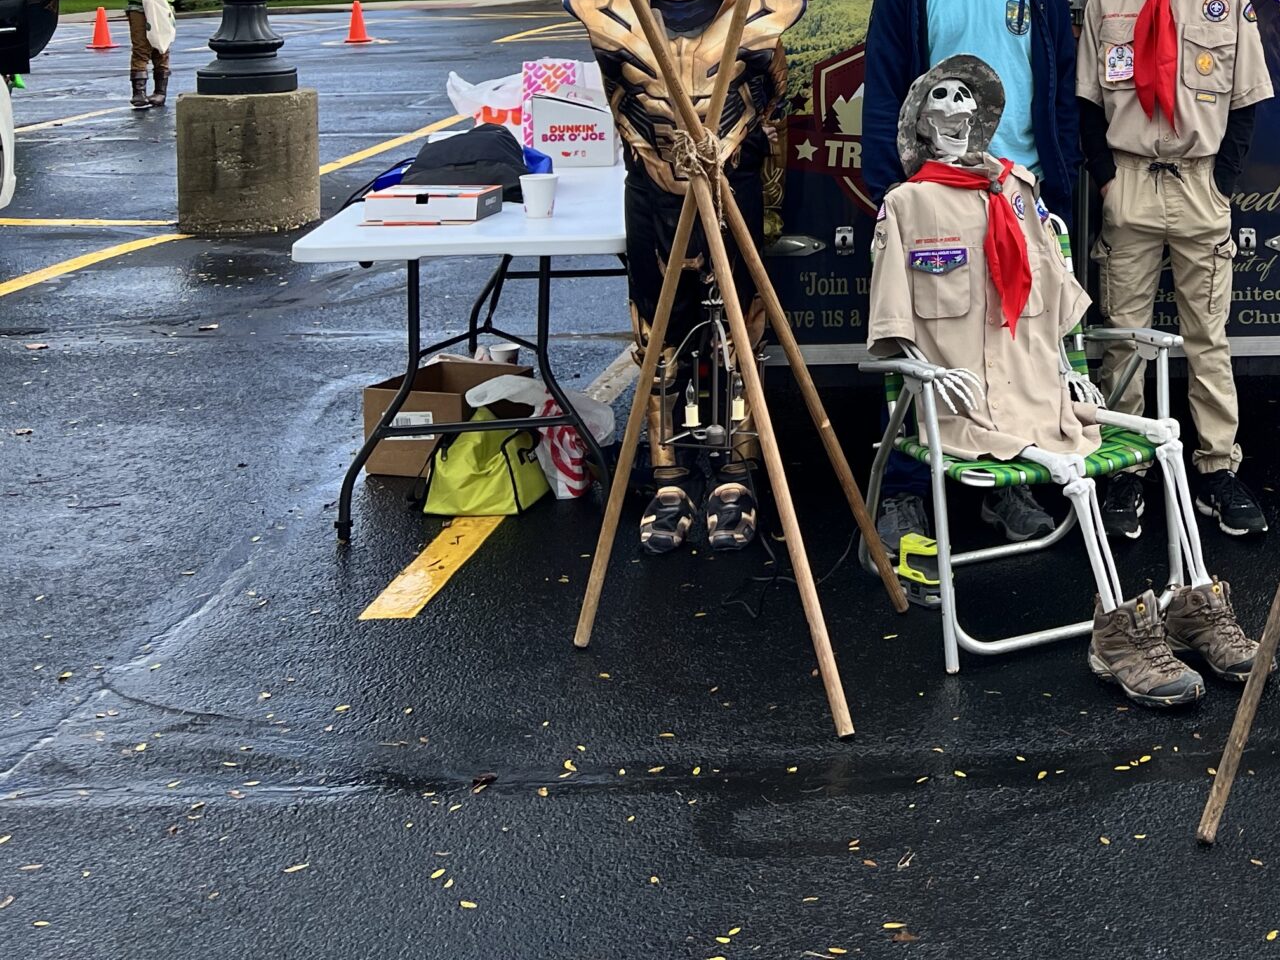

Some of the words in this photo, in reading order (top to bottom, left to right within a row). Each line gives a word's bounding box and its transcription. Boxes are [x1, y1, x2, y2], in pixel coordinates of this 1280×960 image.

[541, 133, 566, 142] BOX
[581, 132, 606, 142] JOE
[549, 123, 598, 133] DUNKIN'
[1256, 254, 1279, 283] of
[855, 276, 871, 296] u
[822, 309, 844, 328] us
